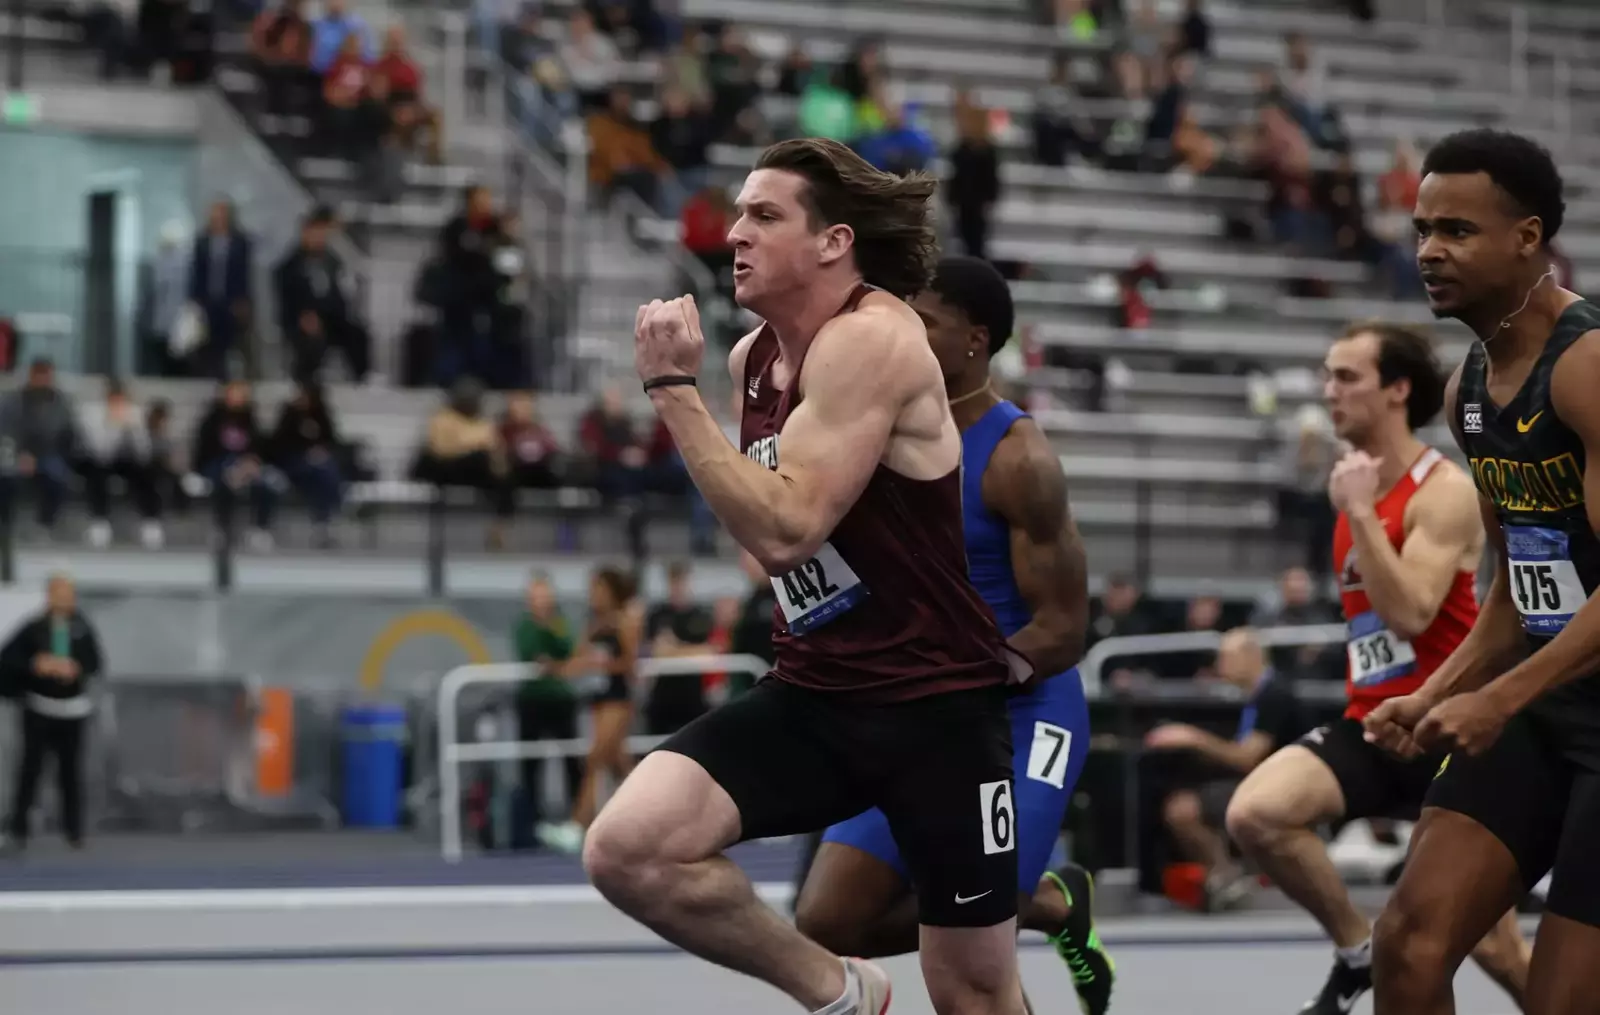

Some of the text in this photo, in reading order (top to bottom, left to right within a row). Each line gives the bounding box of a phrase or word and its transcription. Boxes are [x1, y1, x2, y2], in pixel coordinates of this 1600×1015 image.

[781, 557, 840, 610] 442
[1513, 564, 1562, 611] 475
[1040, 727, 1065, 778] 7
[991, 783, 1010, 849] 6
